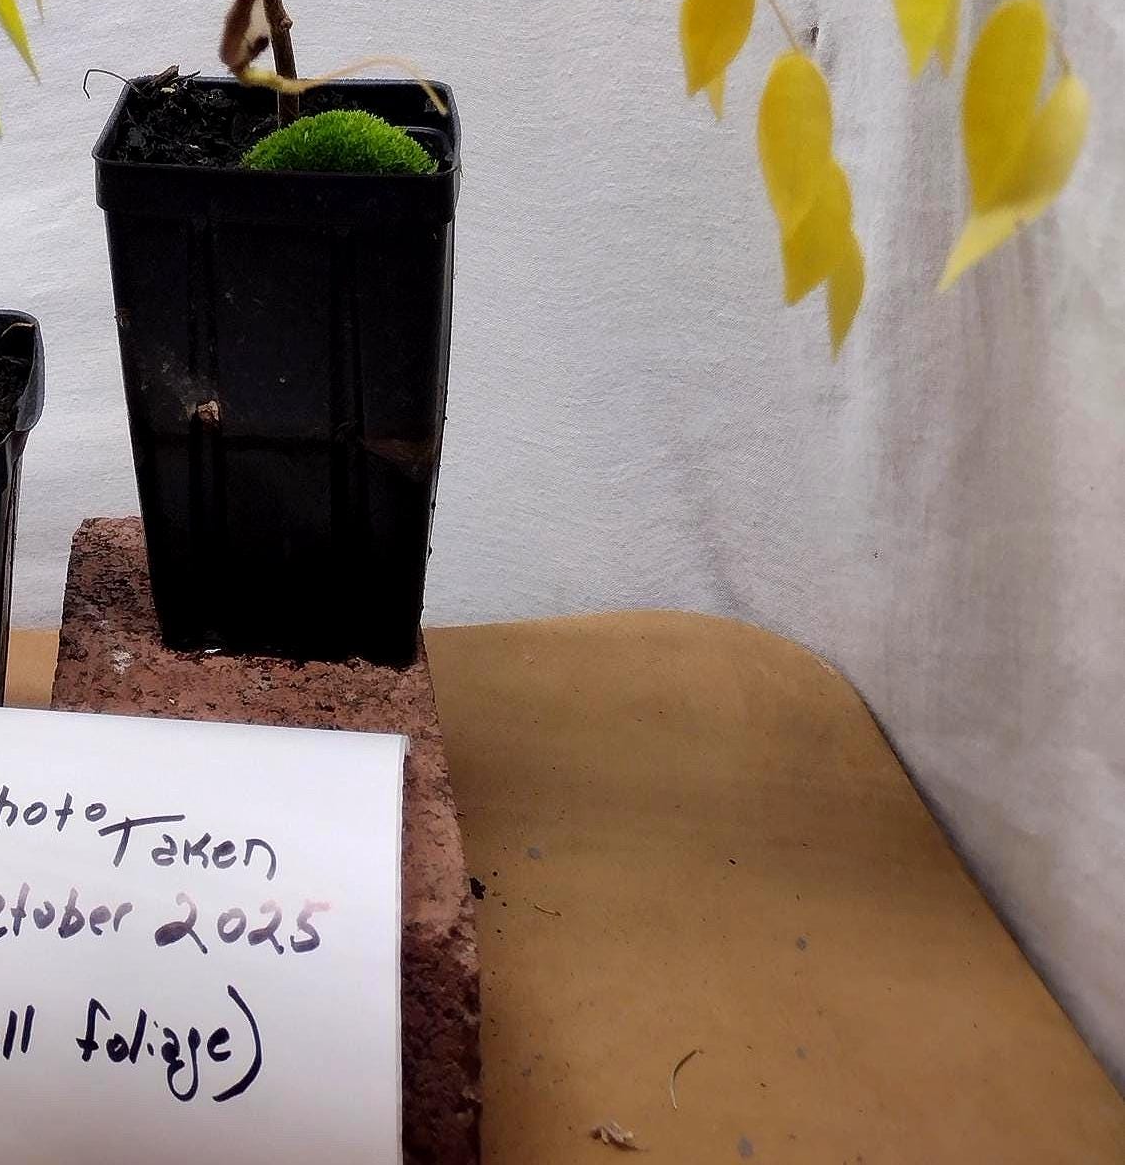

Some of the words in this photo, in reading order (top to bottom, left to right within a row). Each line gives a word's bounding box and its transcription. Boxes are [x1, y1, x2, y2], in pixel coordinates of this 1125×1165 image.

[98, 813, 277, 880] Taken
[155, 893, 332, 955] 2025
[76, 985, 263, 1103] foliage)
